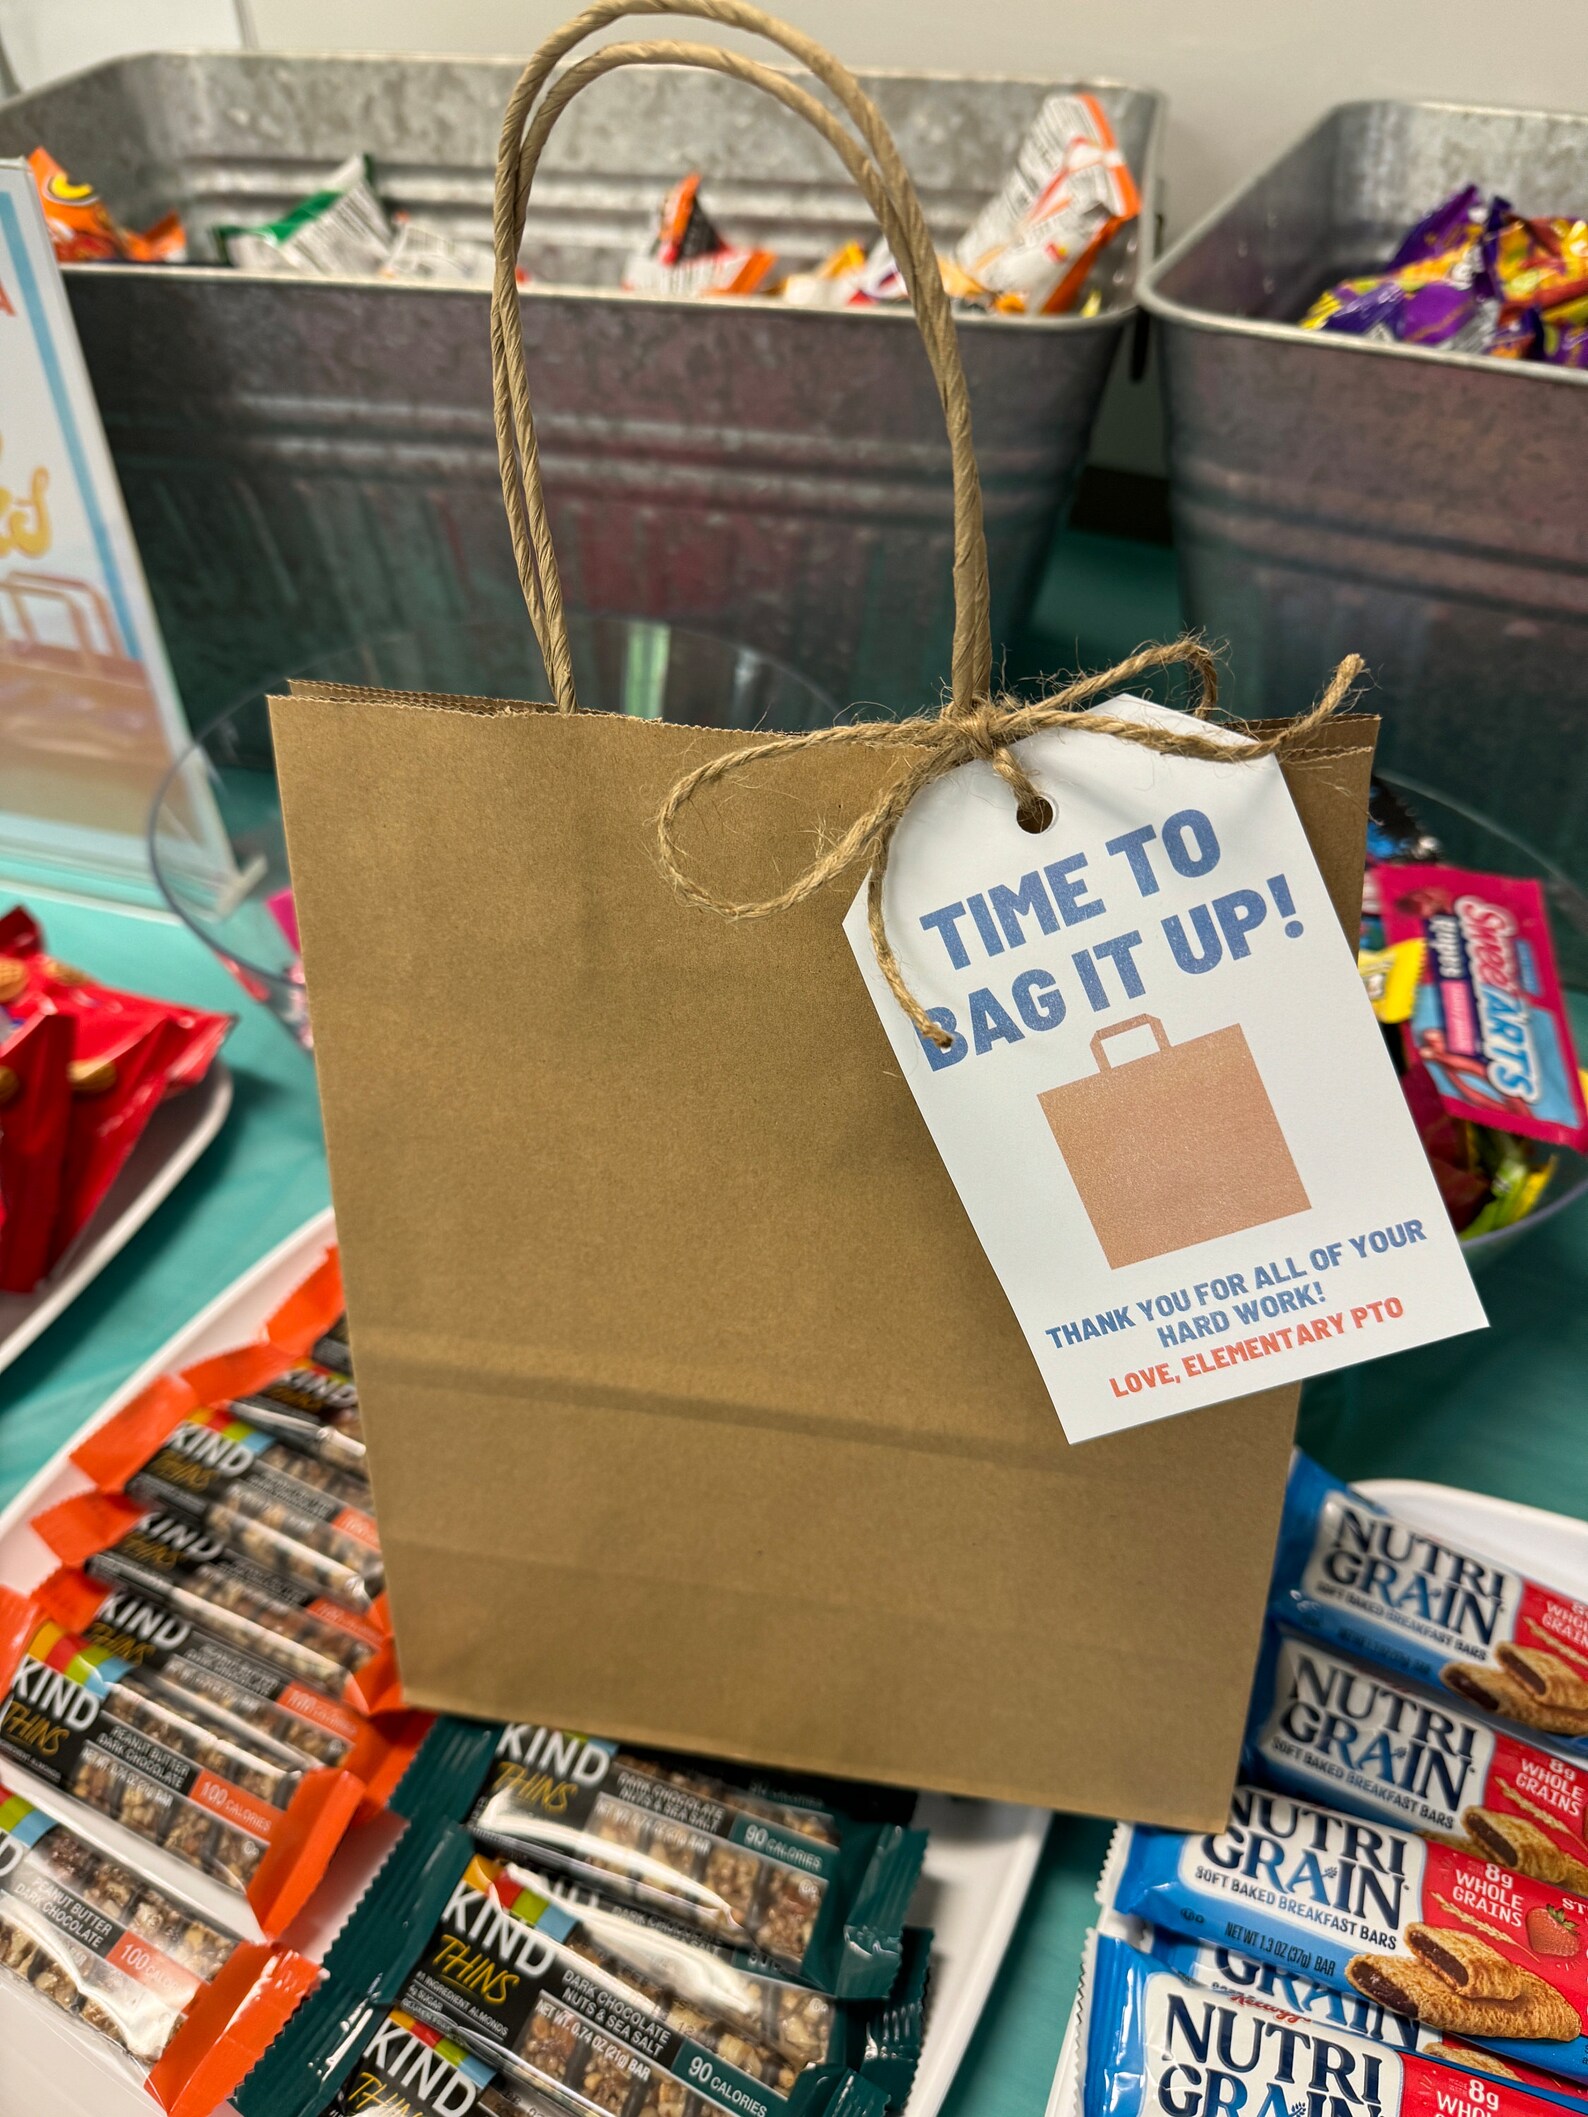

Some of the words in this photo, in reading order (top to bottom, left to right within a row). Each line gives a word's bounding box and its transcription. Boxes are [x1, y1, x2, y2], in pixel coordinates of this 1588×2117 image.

[919, 852, 1106, 970] TIME
[1105, 809, 1221, 897] TO
[913, 968, 1067, 1072] BAG
[1071, 930, 1147, 1012] IT
[1161, 873, 1304, 975] UP!
[1045, 1306, 1136, 1349] THANK
[1136, 1288, 1192, 1322] YOU
[1193, 1272, 1249, 1306] FOR
[1254, 1257, 1307, 1290] ALL
[1309, 1243, 1342, 1271] OF
[1348, 1218, 1427, 1259] YOUR
[1157, 1309, 1230, 1348] HARD
[1232, 1281, 1326, 1326] WORK!
[1108, 1362, 1181, 1398] LOVE,
[1181, 1312, 1344, 1378] ELEMENTARY
[1352, 1296, 1405, 1329] PTO
[166, 1423, 254, 1478] KIND
[139, 1512, 224, 1562] KIND
[1333, 1508, 1504, 1604] NUTRI
[97, 1592, 192, 1650] KIND
[1324, 1550, 1505, 1646] GRAIN
[1385, 1603, 1453, 1648] BREAKFAST
[1454, 1638, 1488, 1661] BARS
[12, 1654, 100, 1732] KIND
[1289, 1655, 1477, 1758] NUTRI
[2, 1700, 70, 1756] THINS
[111, 1726, 150, 1749] PEANUT
[151, 1746, 191, 1777] BUTTER
[495, 1722, 610, 1789] KIND
[1280, 1702, 1472, 1812] GRAIN
[97, 1733, 127, 1755] DARK
[127, 1748, 185, 1789] CHOCOLATE
[1272, 1736, 1302, 1760] SOFT
[1302, 1752, 1345, 1779] BAKED
[1346, 1771, 1418, 1814] BREAKFAST
[1420, 1804, 1455, 1830] BARS
[1521, 1758, 1586, 1804] WHOLE
[1549, 1758, 1576, 1782] 8g
[201, 1781, 228, 1806] 100
[225, 1799, 272, 1832] CALORIES
[1516, 1772, 1584, 1817] GRAINS
[744, 1823, 769, 1847] 90
[766, 1838, 823, 1870] CALORIES
[1202, 1826, 1405, 1931] GRAIN
[1485, 1863, 1513, 1889] 8g
[14, 1884, 45, 1908] DARK
[42, 1899, 105, 1948] CHOCOLATE
[32, 1876, 74, 1908] PEANUT
[71, 1902, 113, 1936] BUTTER
[1195, 1865, 1229, 1888] SOFT
[1231, 1878, 1276, 1905] BAKED
[1278, 1895, 1357, 1936] BREAKFAST
[1359, 1925, 1398, 1950] BARS
[1452, 1886, 1523, 1928] GRAINS
[1455, 1869, 1524, 1912] WHOLE
[121, 1944, 150, 1970] 100
[441, 1880, 555, 1979] KIND
[1225, 1922, 1243, 1940] NET
[1243, 1927, 1259, 1945] WT
[1260, 1933, 1273, 1949] 1.3
[1273, 1937, 1288, 1955] OZ
[1315, 1953, 1336, 1977] BAR
[418, 1988, 444, 2013] SUGAR
[432, 1934, 520, 2004] THINS
[425, 1973, 471, 2012] INGREDIENT
[468, 2006, 509, 2037] ALMONDS
[561, 1987, 596, 2015] NUTS
[595, 2009, 606, 2022] &
[605, 2013, 631, 2040] SEA
[630, 2030, 664, 2058] SALT
[562, 1969, 597, 1997] DARK
[597, 1991, 671, 2045] CHOCOLATE
[364, 2018, 477, 2117] KIND
[535, 1999, 556, 2018] NET
[554, 2008, 571, 2029] WT.
[570, 2019, 593, 2044] 0.74
[591, 2032, 607, 2051] OZ
[606, 2042, 629, 2069] (21g)
[628, 2058, 651, 2082] BAR
[1161, 1993, 1382, 2105] NUTRI
[688, 2056, 713, 2083] 90
[709, 2079, 769, 2117] CALORIES
[1468, 2079, 1499, 2111] 8g
